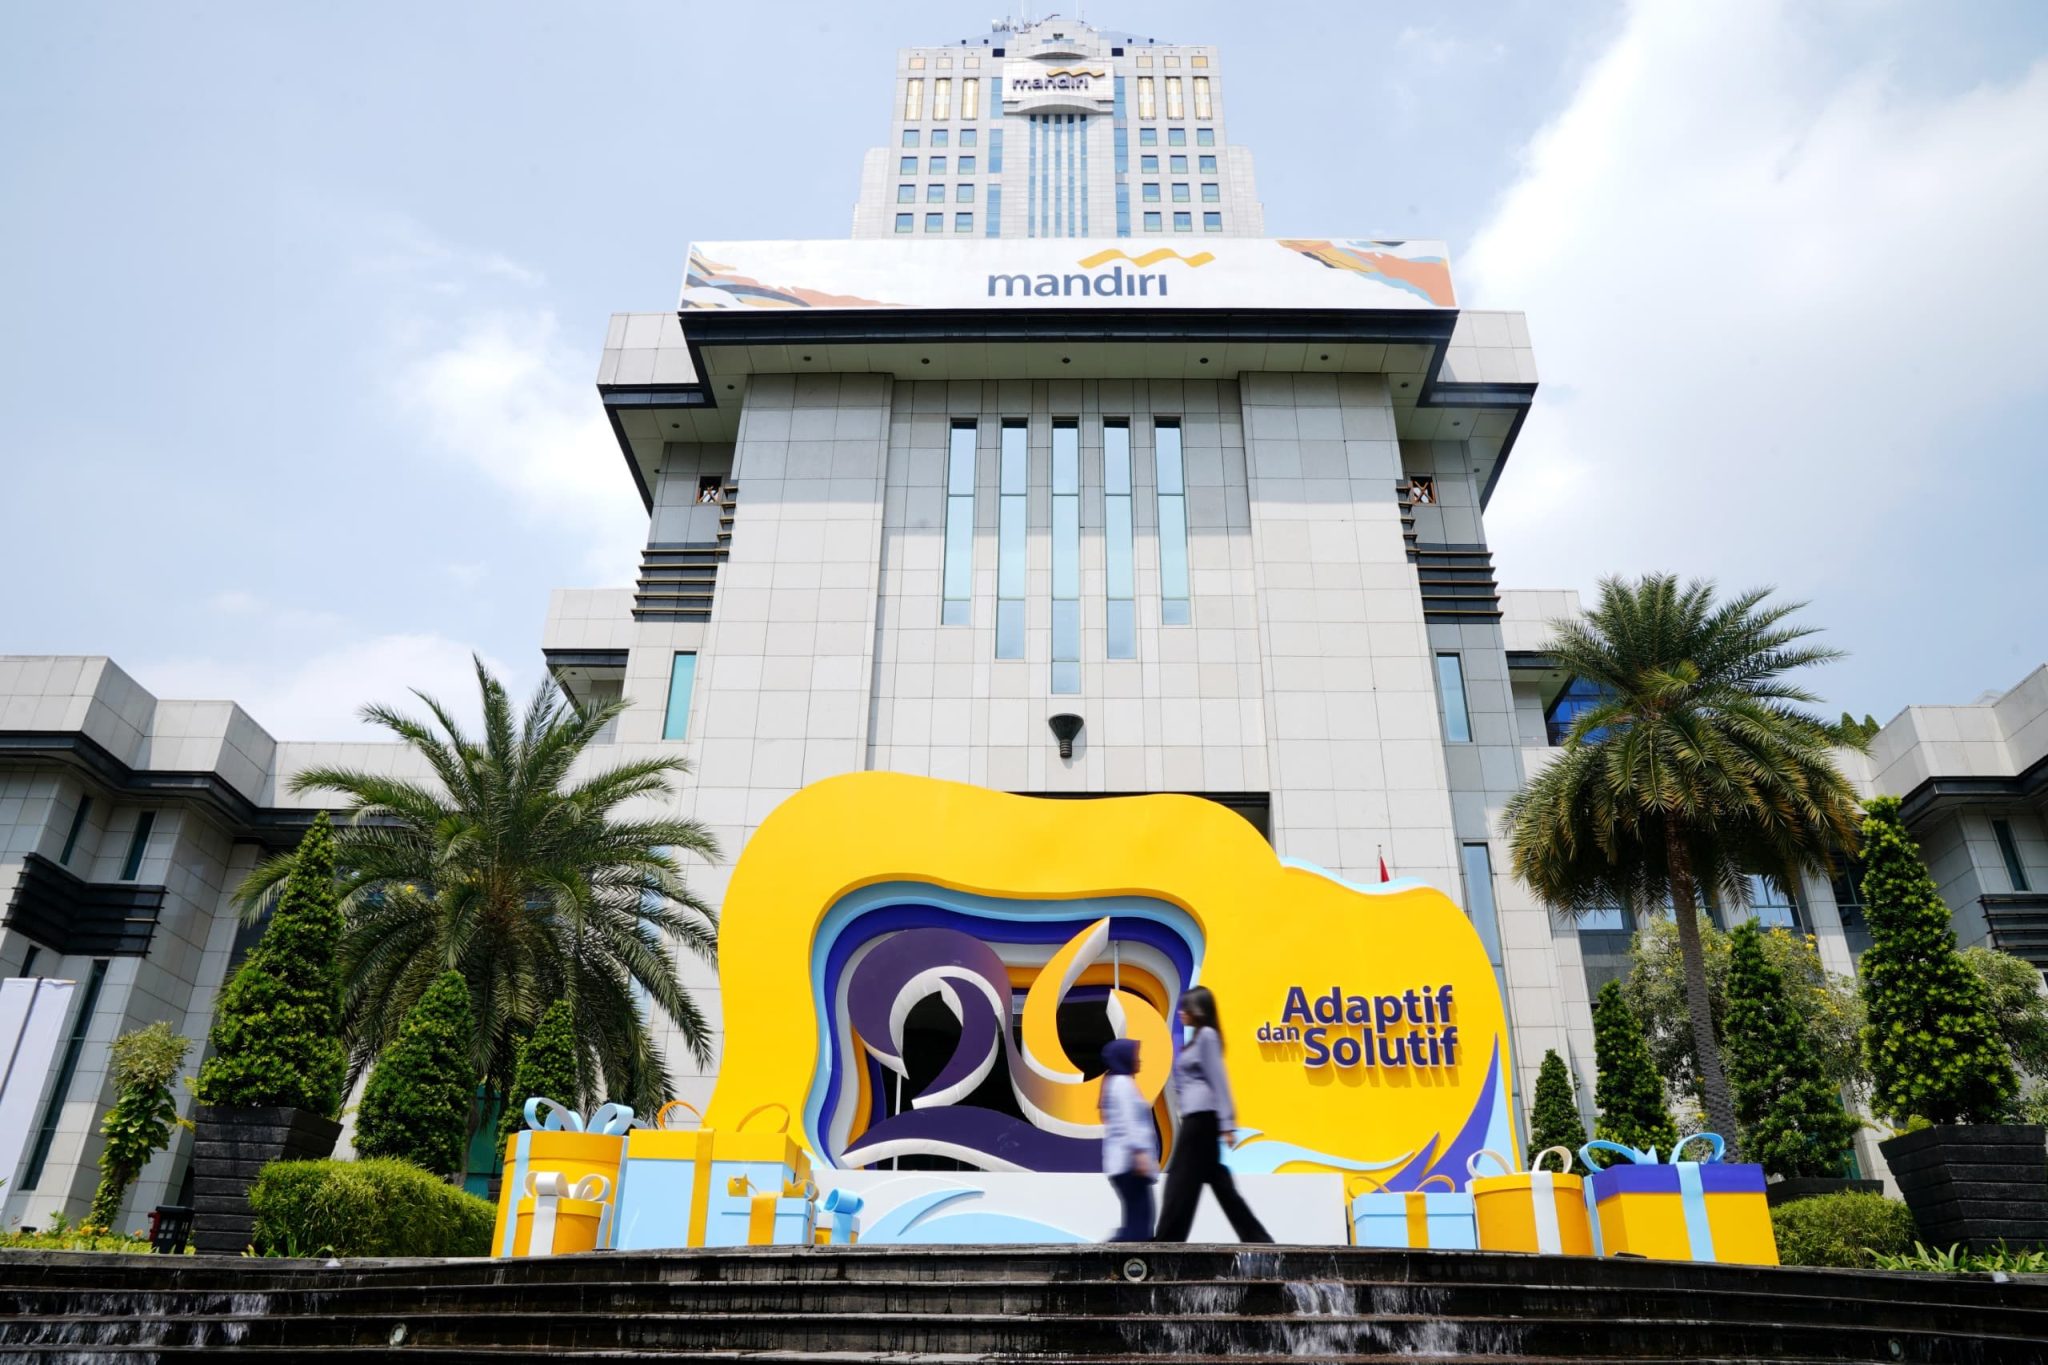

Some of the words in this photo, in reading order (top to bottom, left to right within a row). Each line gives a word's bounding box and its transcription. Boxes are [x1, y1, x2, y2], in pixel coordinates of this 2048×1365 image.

[1012, 76, 1089, 91] mandiri
[988, 264, 1168, 296] mandiri
[1281, 984, 1453, 1035] Adaptif
[1257, 1022, 1300, 1043] dan
[1303, 1026, 1458, 1068] Solutif
